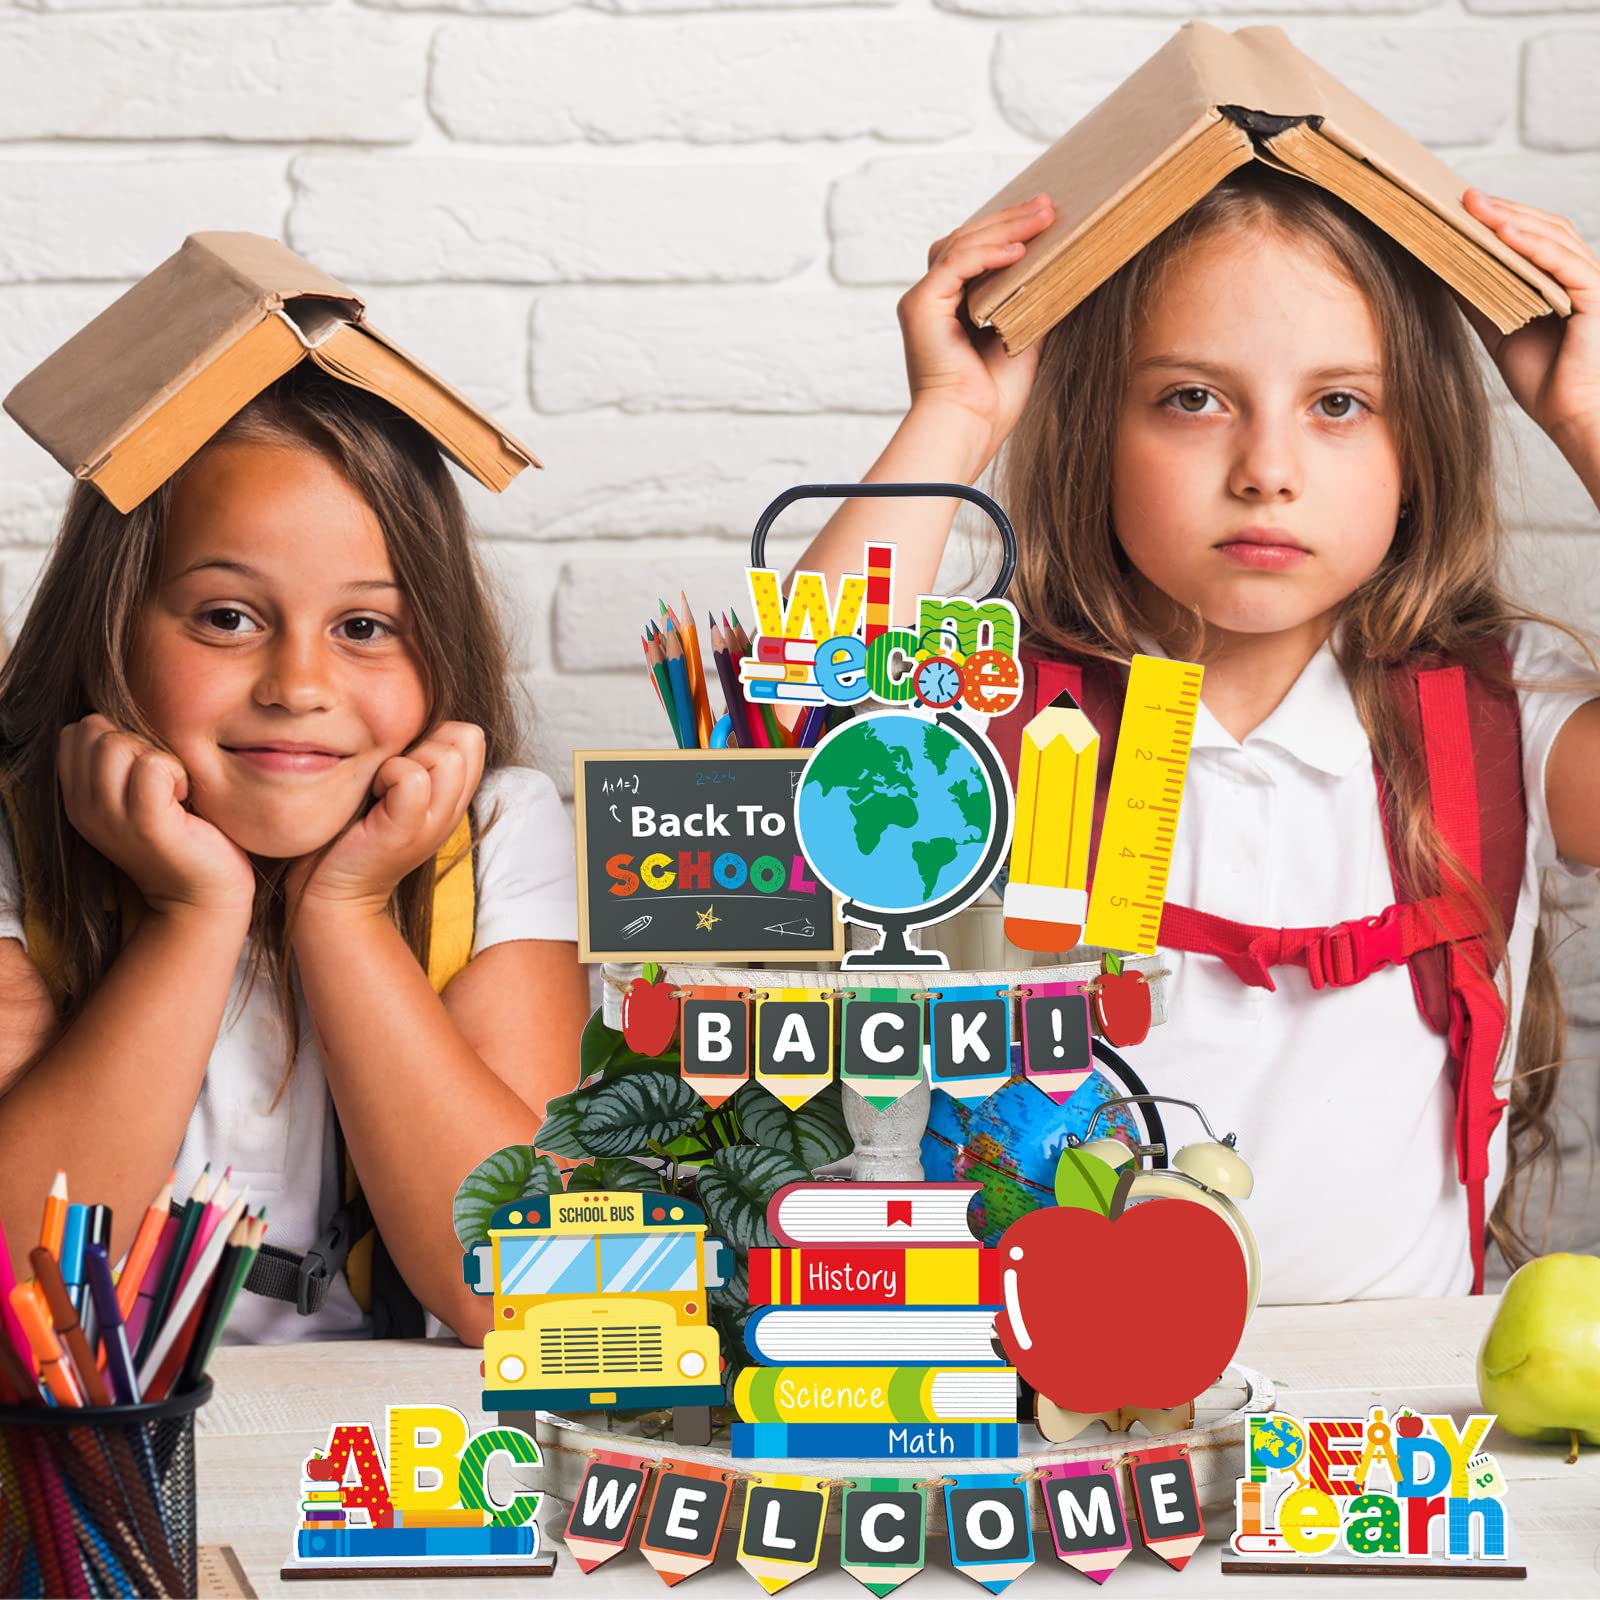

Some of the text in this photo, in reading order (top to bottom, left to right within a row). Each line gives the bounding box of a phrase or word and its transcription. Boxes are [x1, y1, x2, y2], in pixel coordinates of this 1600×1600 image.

[1135, 748, 1153, 761] 2
[631, 803, 787, 838] Back To
[1127, 798, 1145, 810] 3
[1118, 846, 1136, 858] 4
[604, 850, 818, 897] SCHOOL
[1110, 895, 1129, 908] 5
[559, 1205, 635, 1223] SCHOOL BUS
[809, 1261, 897, 1298] History
[779, 1379, 886, 1410] Science
[888, 1427, 955, 1455] Math
[1250, 1411, 1494, 1498] READY to
[312, 1408, 540, 1529] ABC
[582, 1472, 1185, 1553] WELCOME
[1235, 1482, 1505, 1556] Learn
